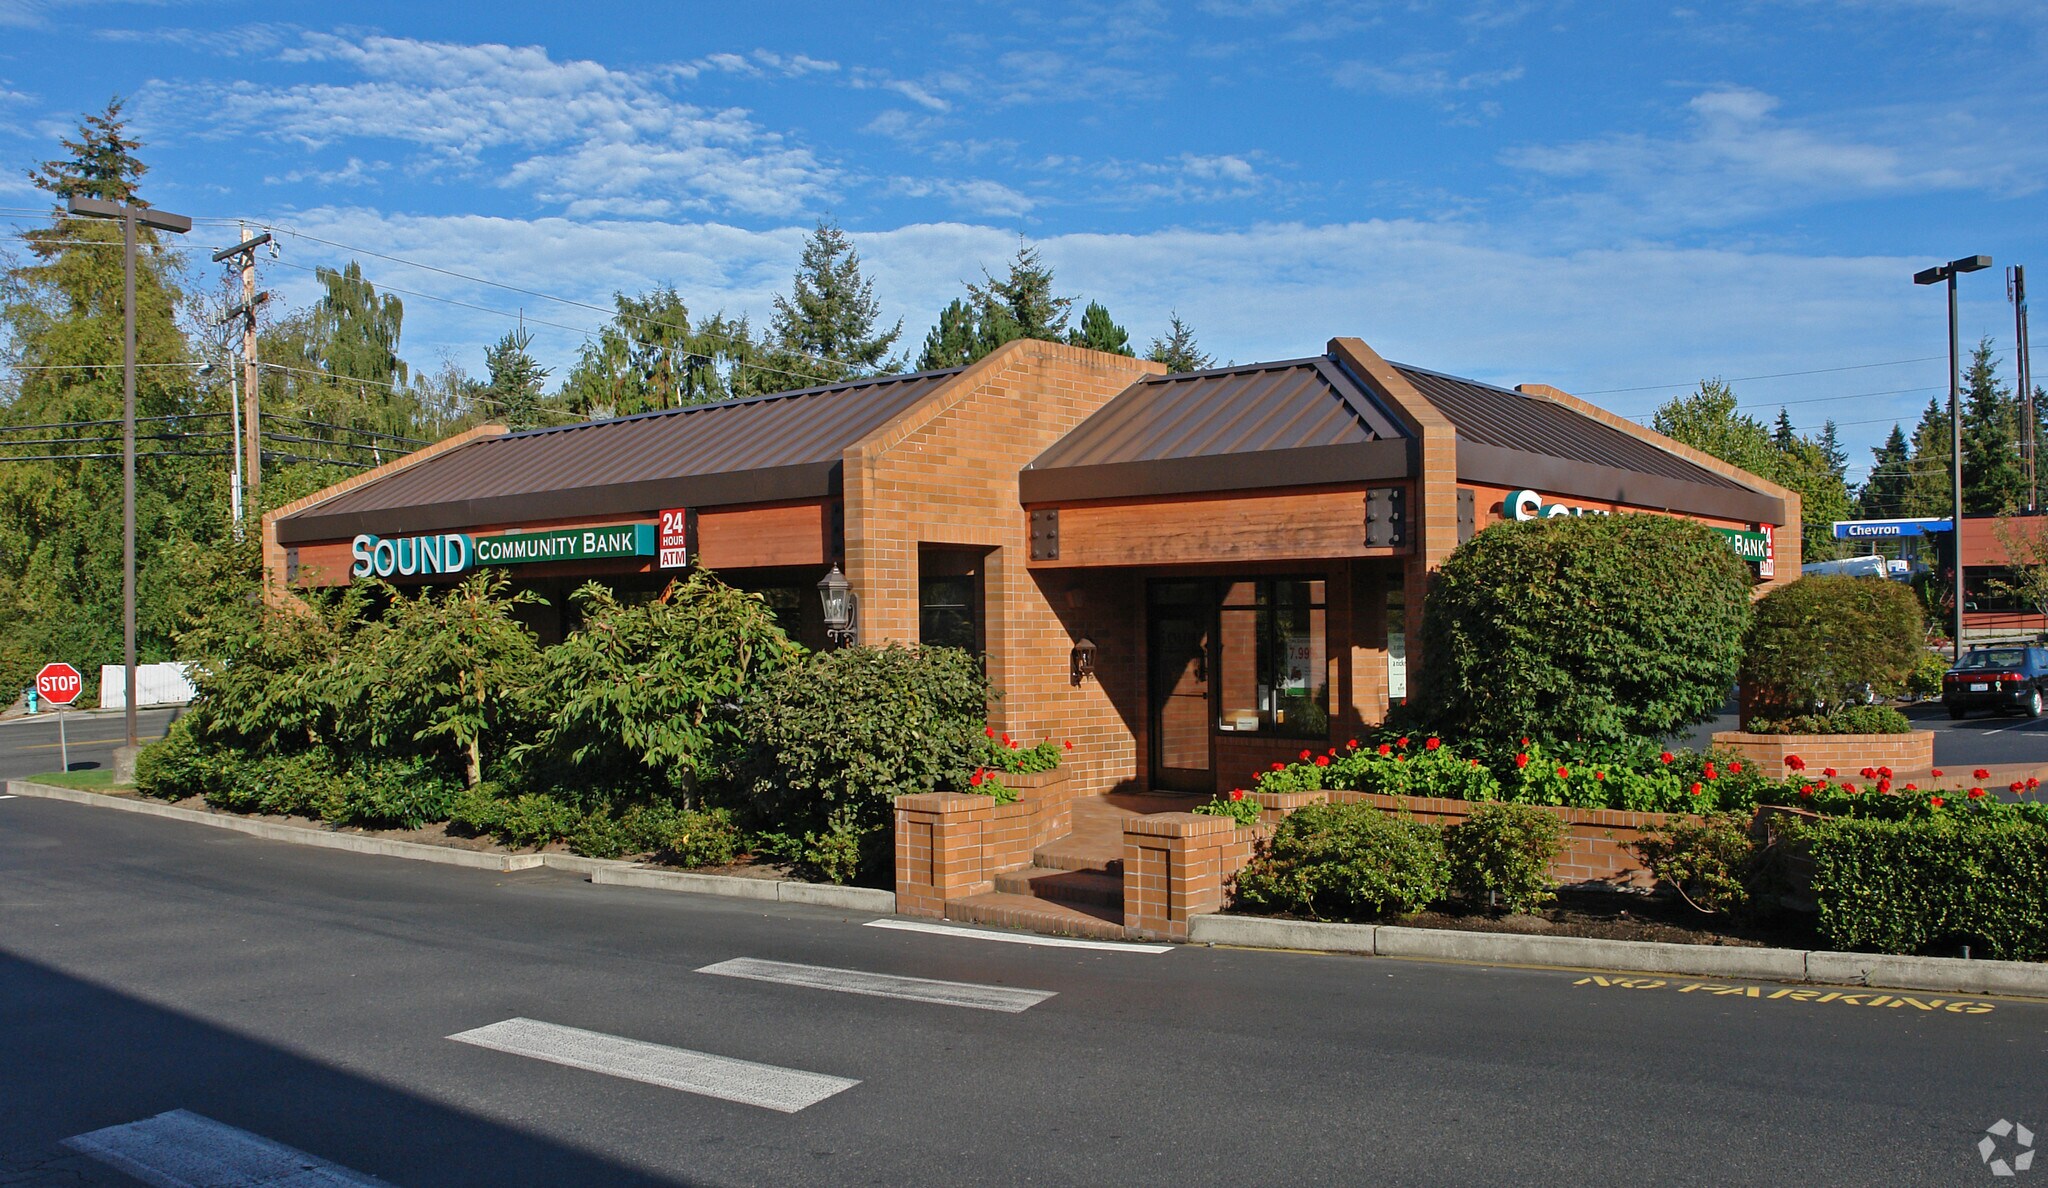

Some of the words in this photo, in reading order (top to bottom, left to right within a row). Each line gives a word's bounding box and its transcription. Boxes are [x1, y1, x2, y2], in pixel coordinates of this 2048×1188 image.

[662, 511, 683, 535] 24
[1848, 524, 1900, 536] Chevron
[662, 535, 684, 547] HOUR
[1734, 534, 1766, 558] BANK
[352, 533, 469, 578] SOUND
[477, 536, 578, 561] COMMUNITY
[583, 531, 633, 554] BANK
[661, 550, 685, 566] ATM
[40, 675, 79, 692] STOP
[1572, 975, 1668, 990] NO
[1676, 982, 1997, 1014] PARKING
